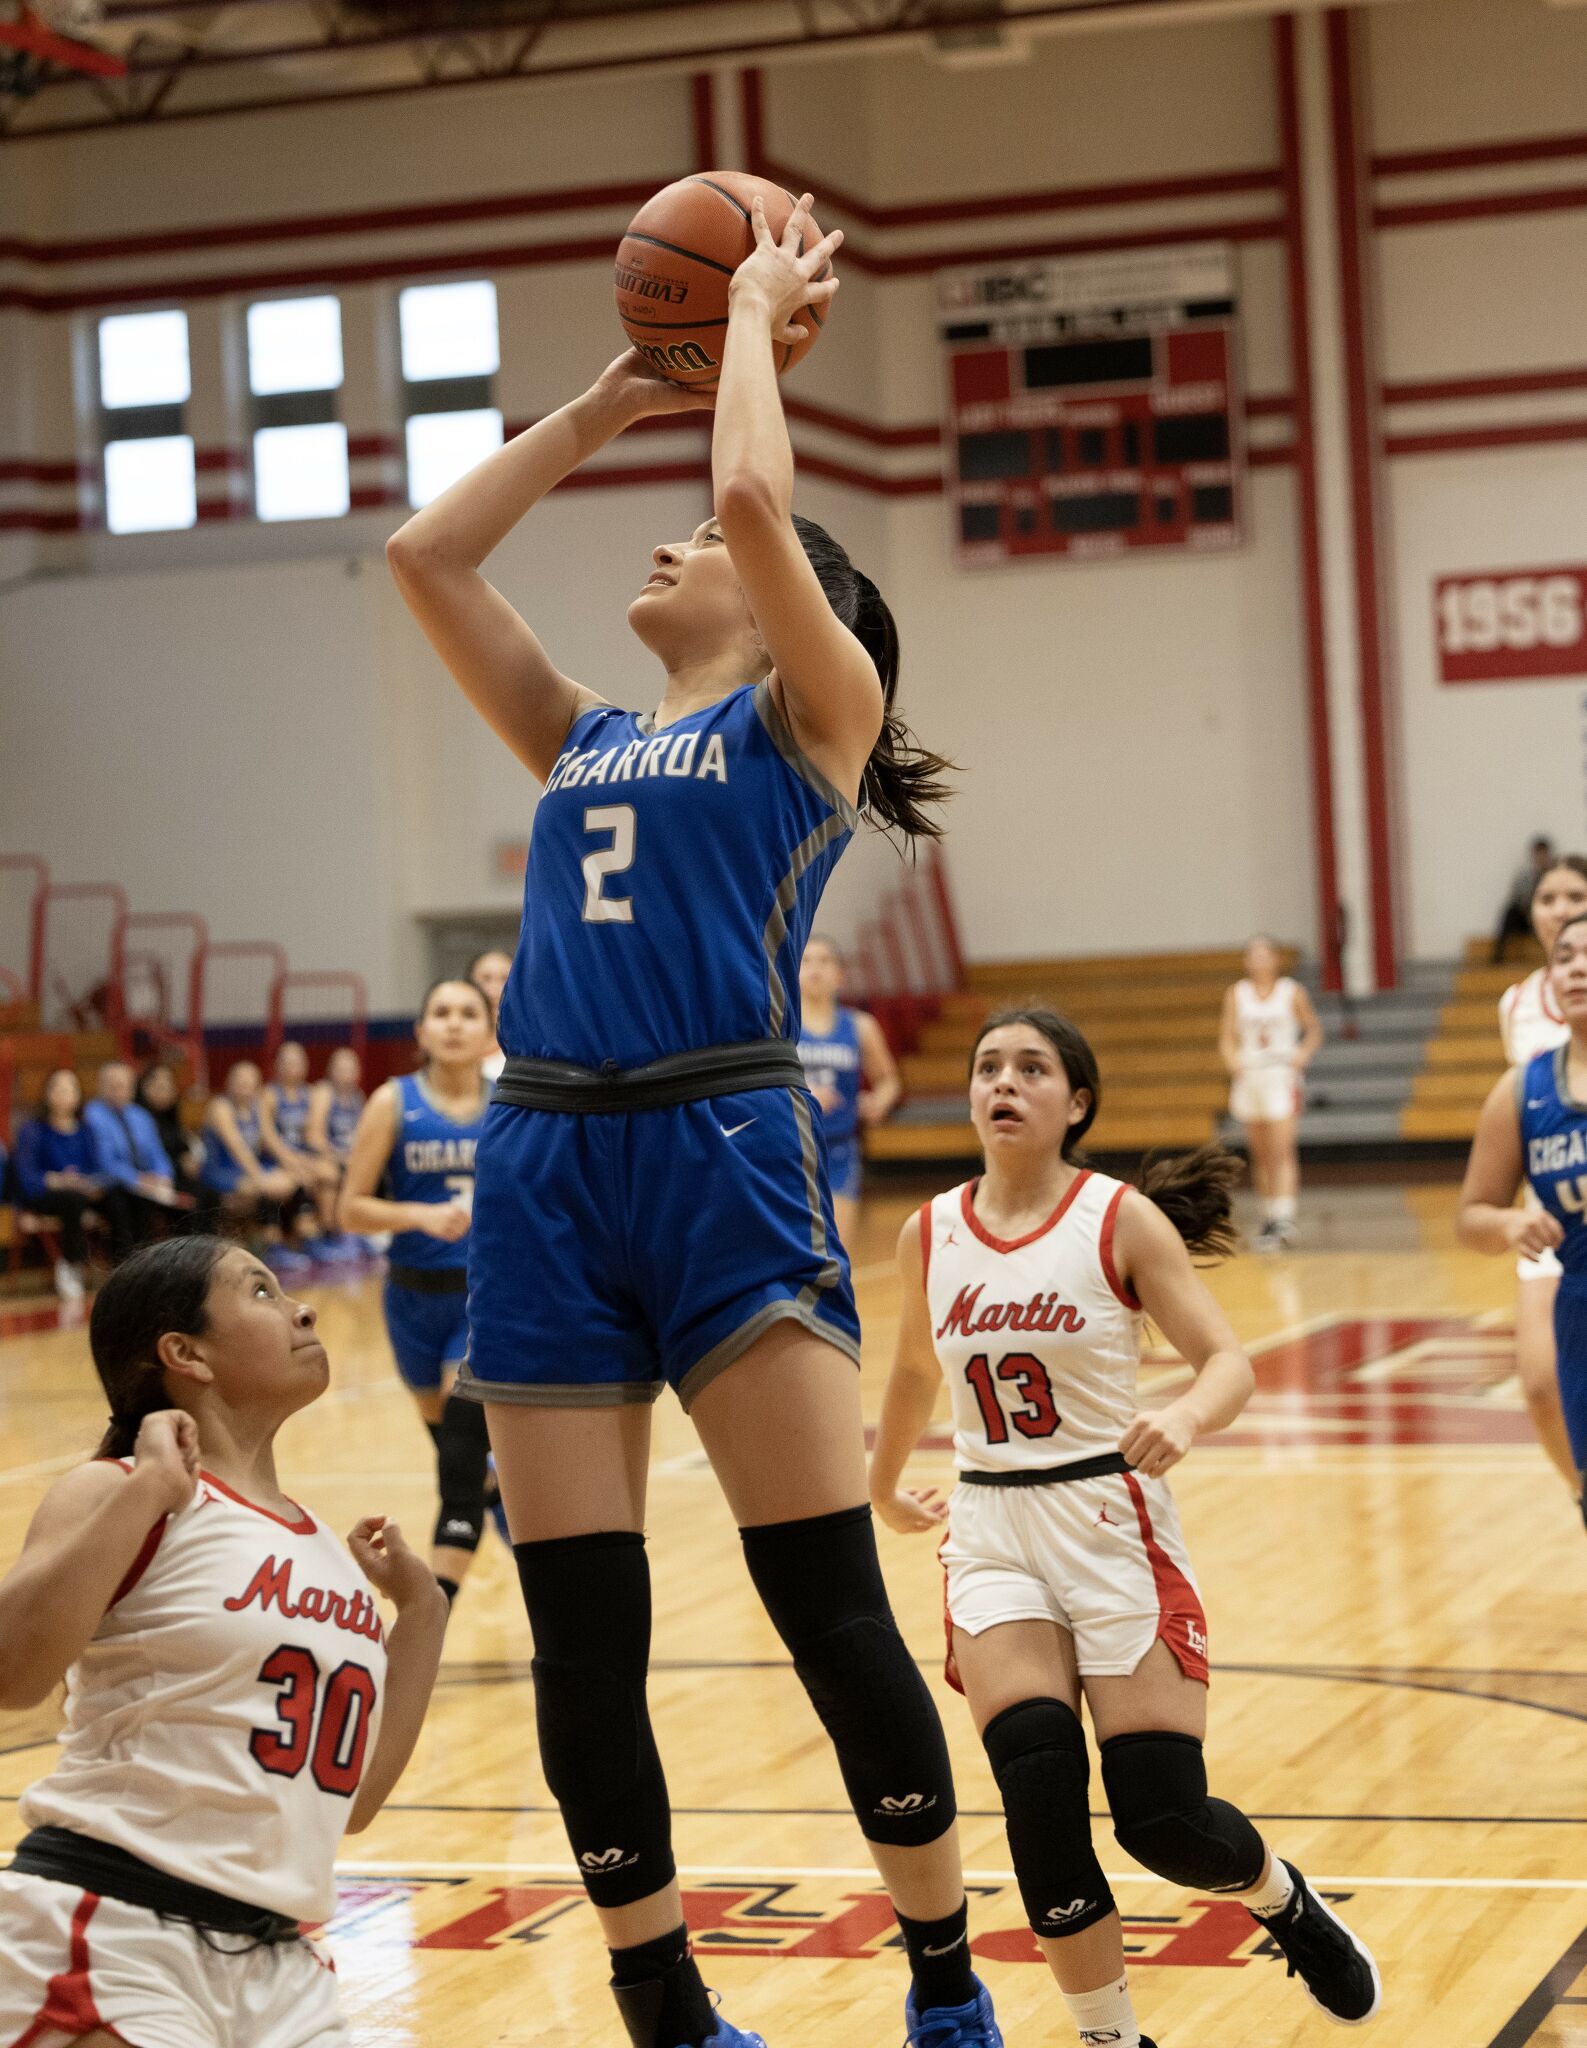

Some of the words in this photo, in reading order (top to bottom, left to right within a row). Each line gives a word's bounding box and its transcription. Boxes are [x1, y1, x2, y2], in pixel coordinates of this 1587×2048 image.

[1441, 575, 1582, 655] 1956
[540, 730, 728, 799] CIGARROA
[580, 802, 637, 925] 2
[936, 1282, 1086, 1340] Martin
[964, 1352, 1062, 1445] 13
[248, 1643, 376, 1799] 30
